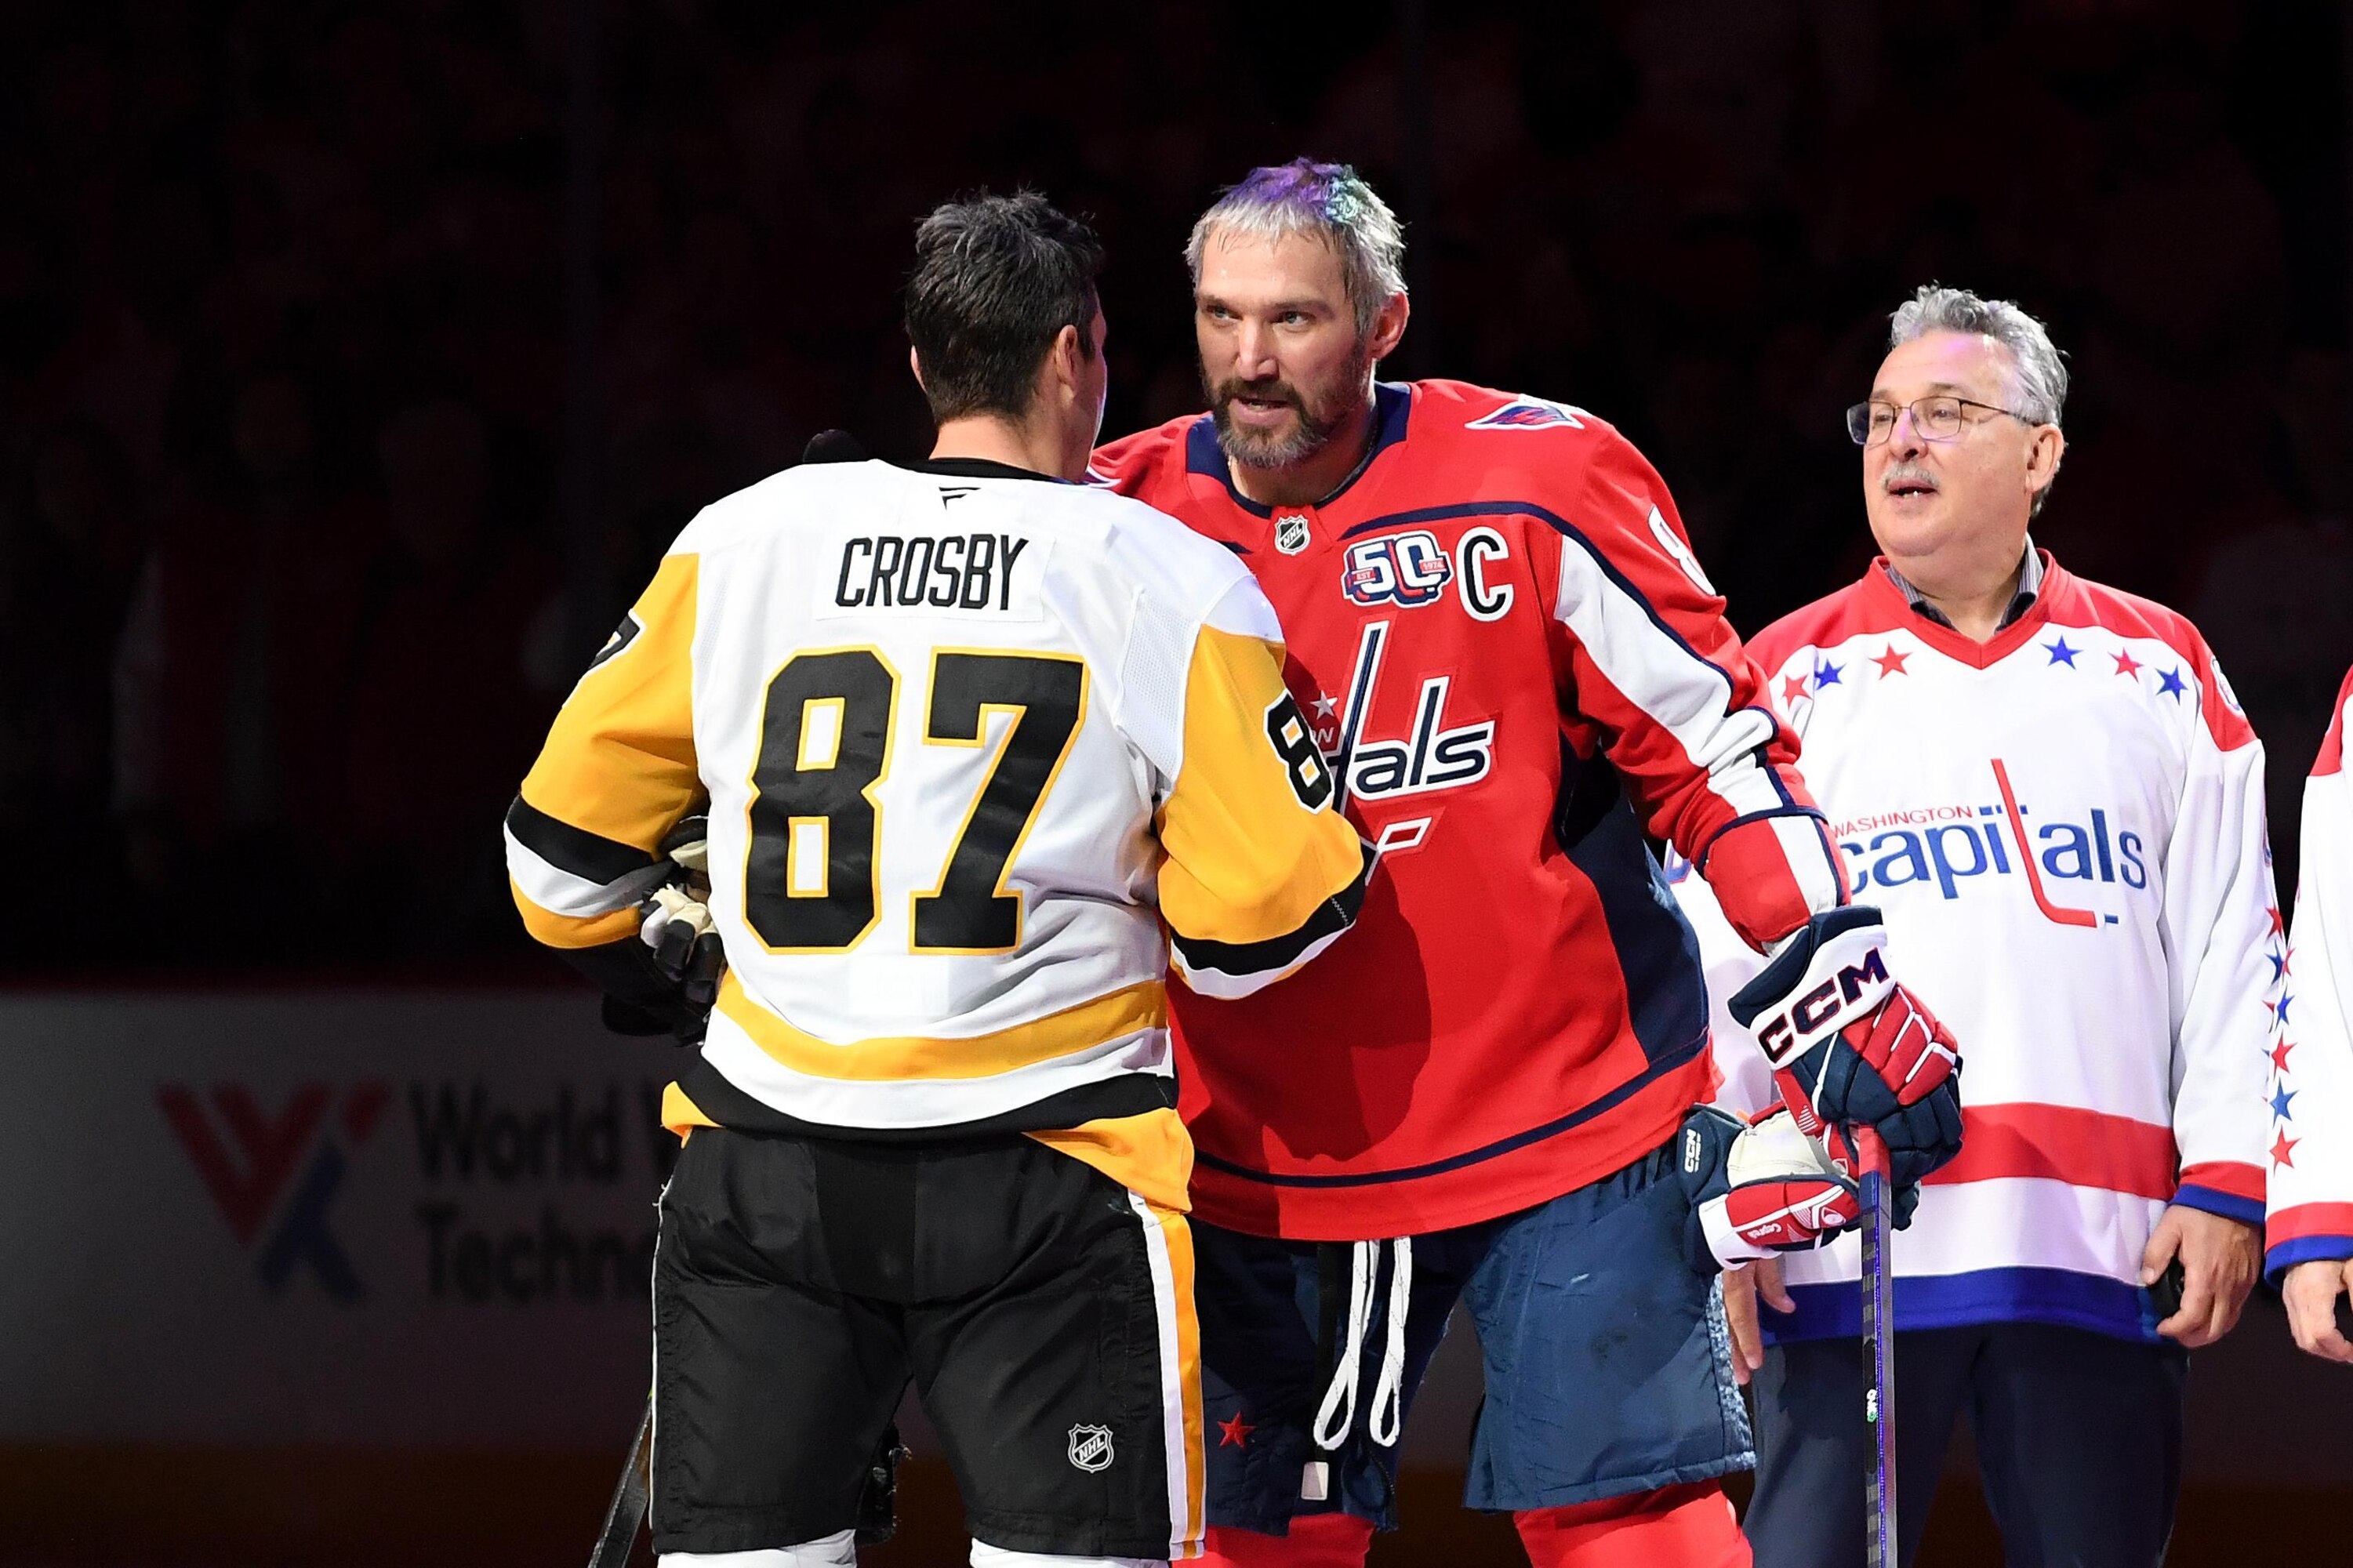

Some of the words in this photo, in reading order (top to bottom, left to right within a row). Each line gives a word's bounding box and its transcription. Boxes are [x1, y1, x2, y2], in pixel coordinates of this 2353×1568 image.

[835, 534, 1029, 610] CROSBY
[1283, 524, 1302, 548] NHL
[1352, 533, 1444, 596] 50
[1422, 559, 1444, 573] 1974
[1456, 526, 1514, 622] C
[742, 644, 1091, 955] 87
[1829, 805, 1973, 838] WASHINGTON
[1757, 946, 1890, 1064] CCM
[409, 1081, 622, 1180] World
[414, 1201, 655, 1301] Techn
[1078, 1436, 1105, 1461] NHL
